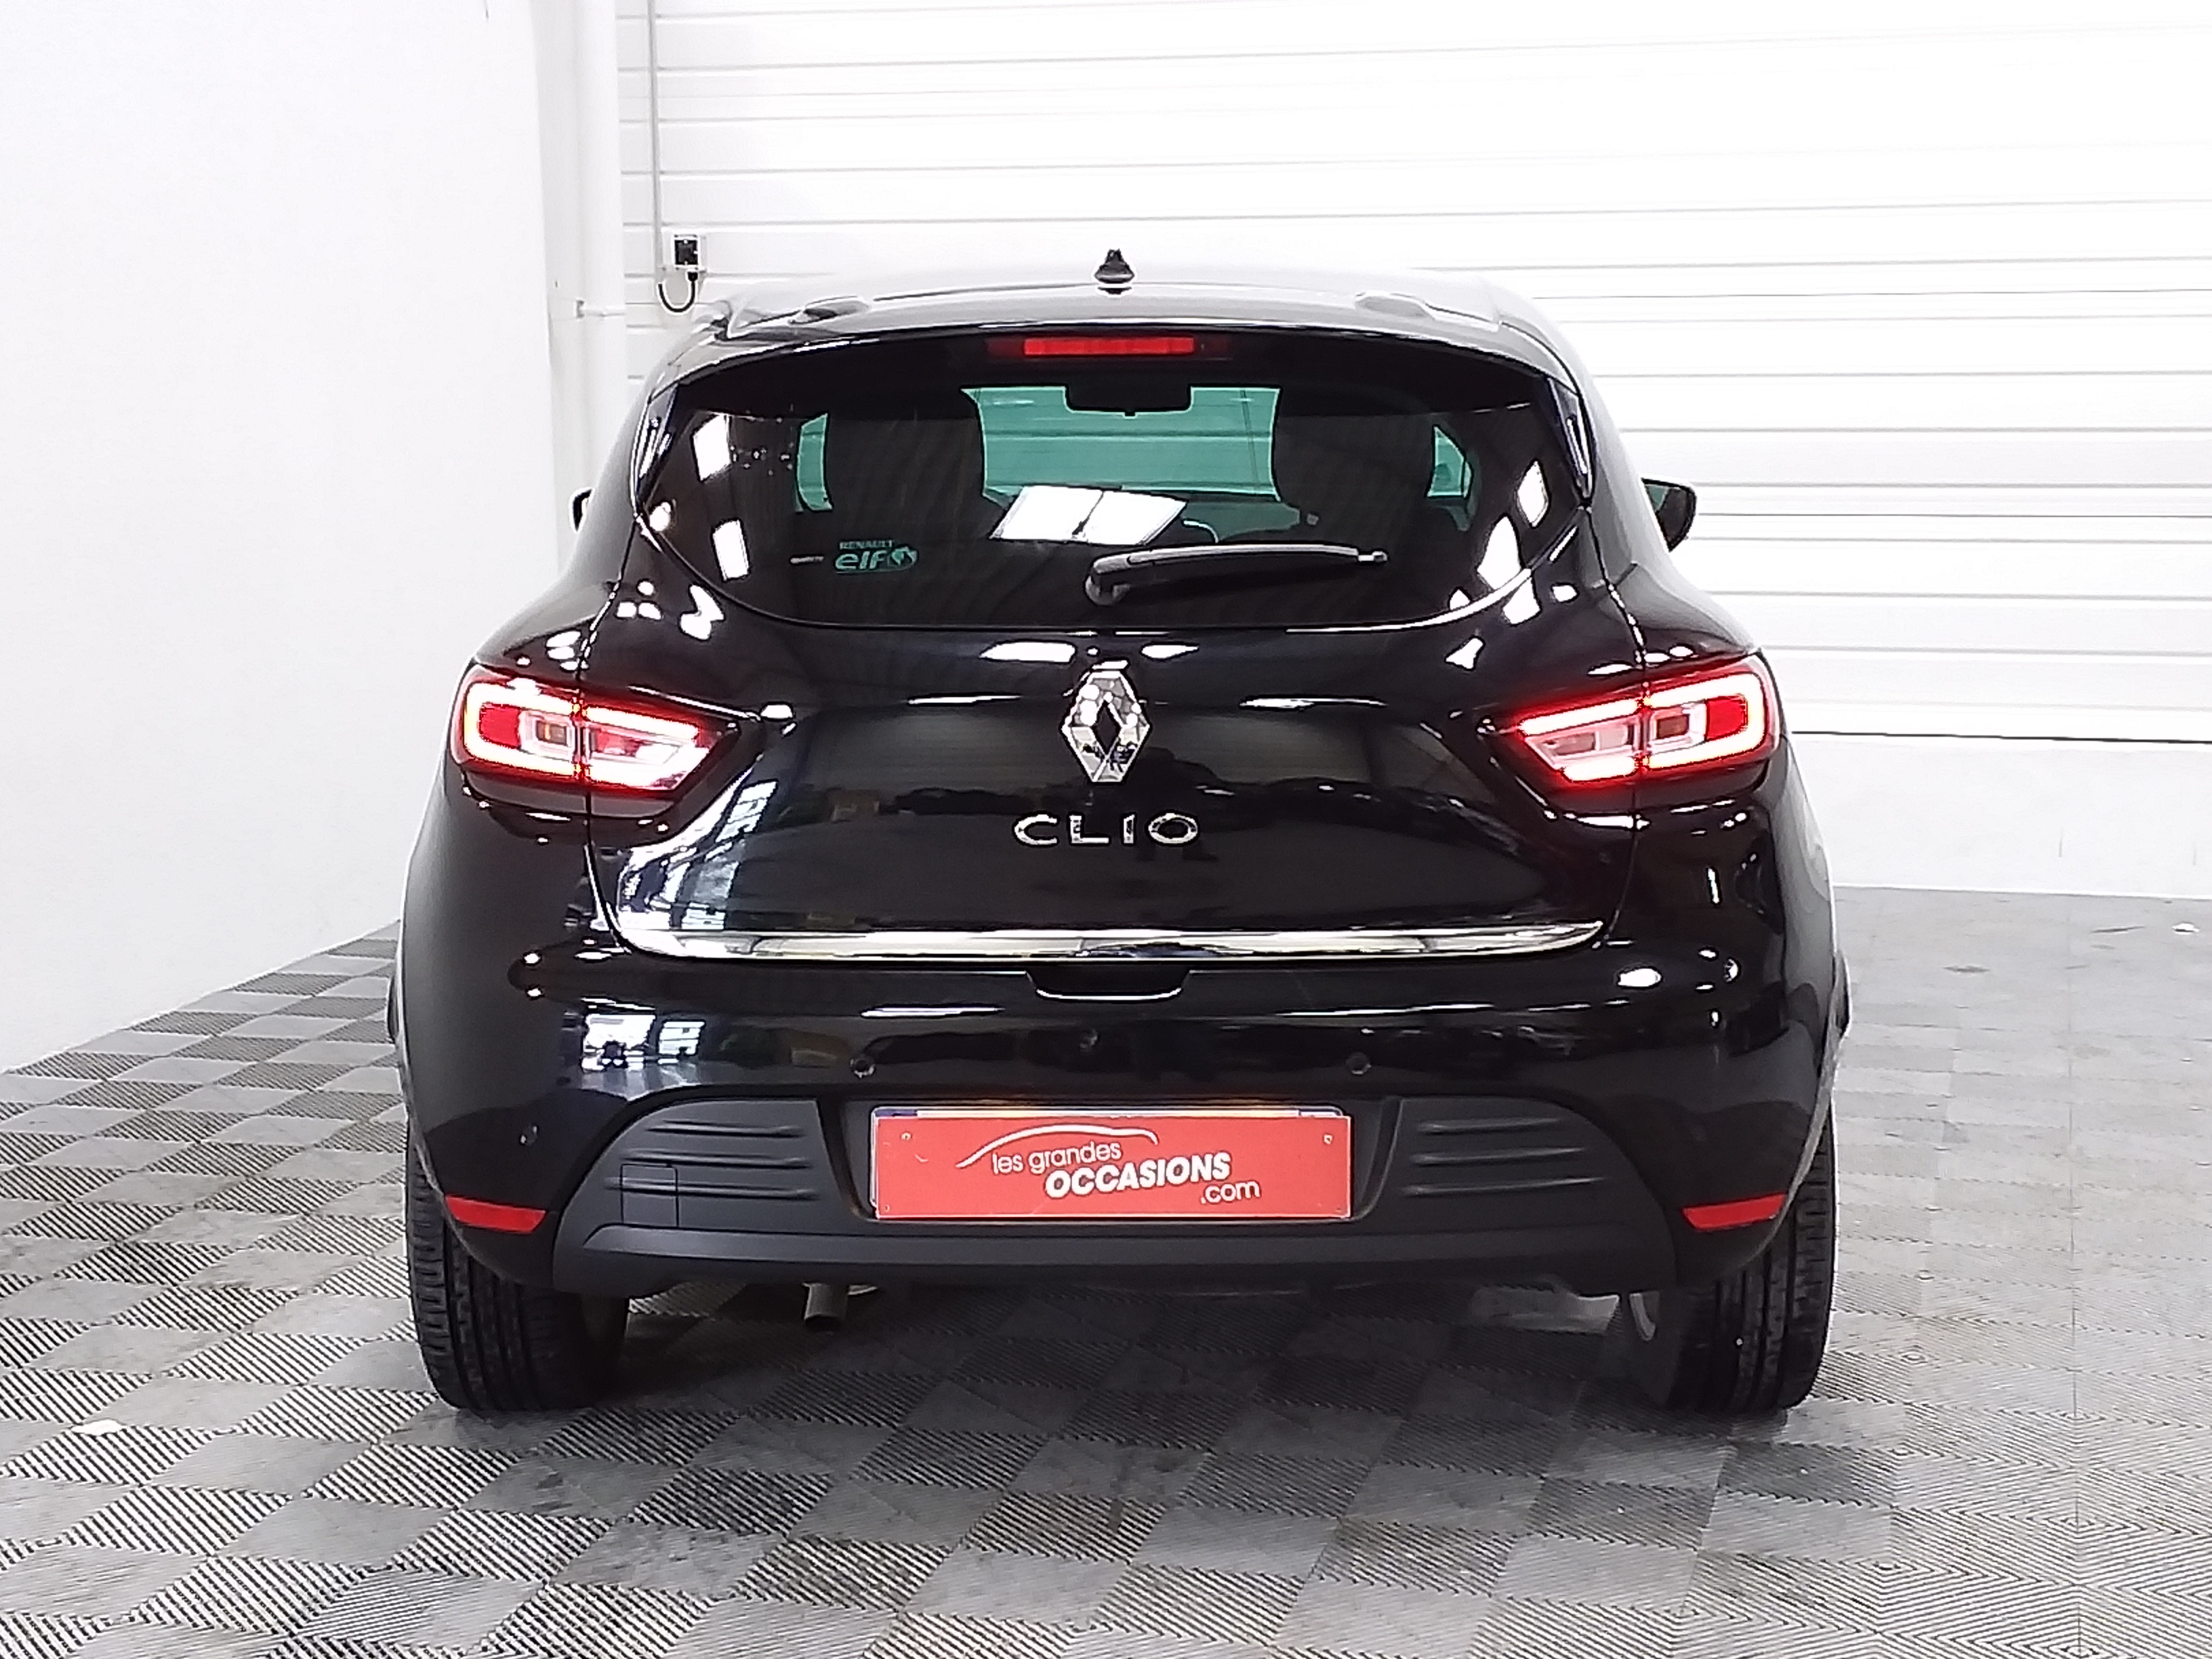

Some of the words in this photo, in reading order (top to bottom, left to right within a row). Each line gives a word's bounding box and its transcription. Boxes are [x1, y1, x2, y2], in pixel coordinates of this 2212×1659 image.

[835, 550, 887, 570] elf
[1015, 813, 1197, 845] CLIO
[992, 1152, 1023, 1174] les
[1029, 1141, 1122, 1174] grandes
[1045, 1151, 1231, 1198] OCCASIONS
[1200, 1181, 1261, 1204] .com
